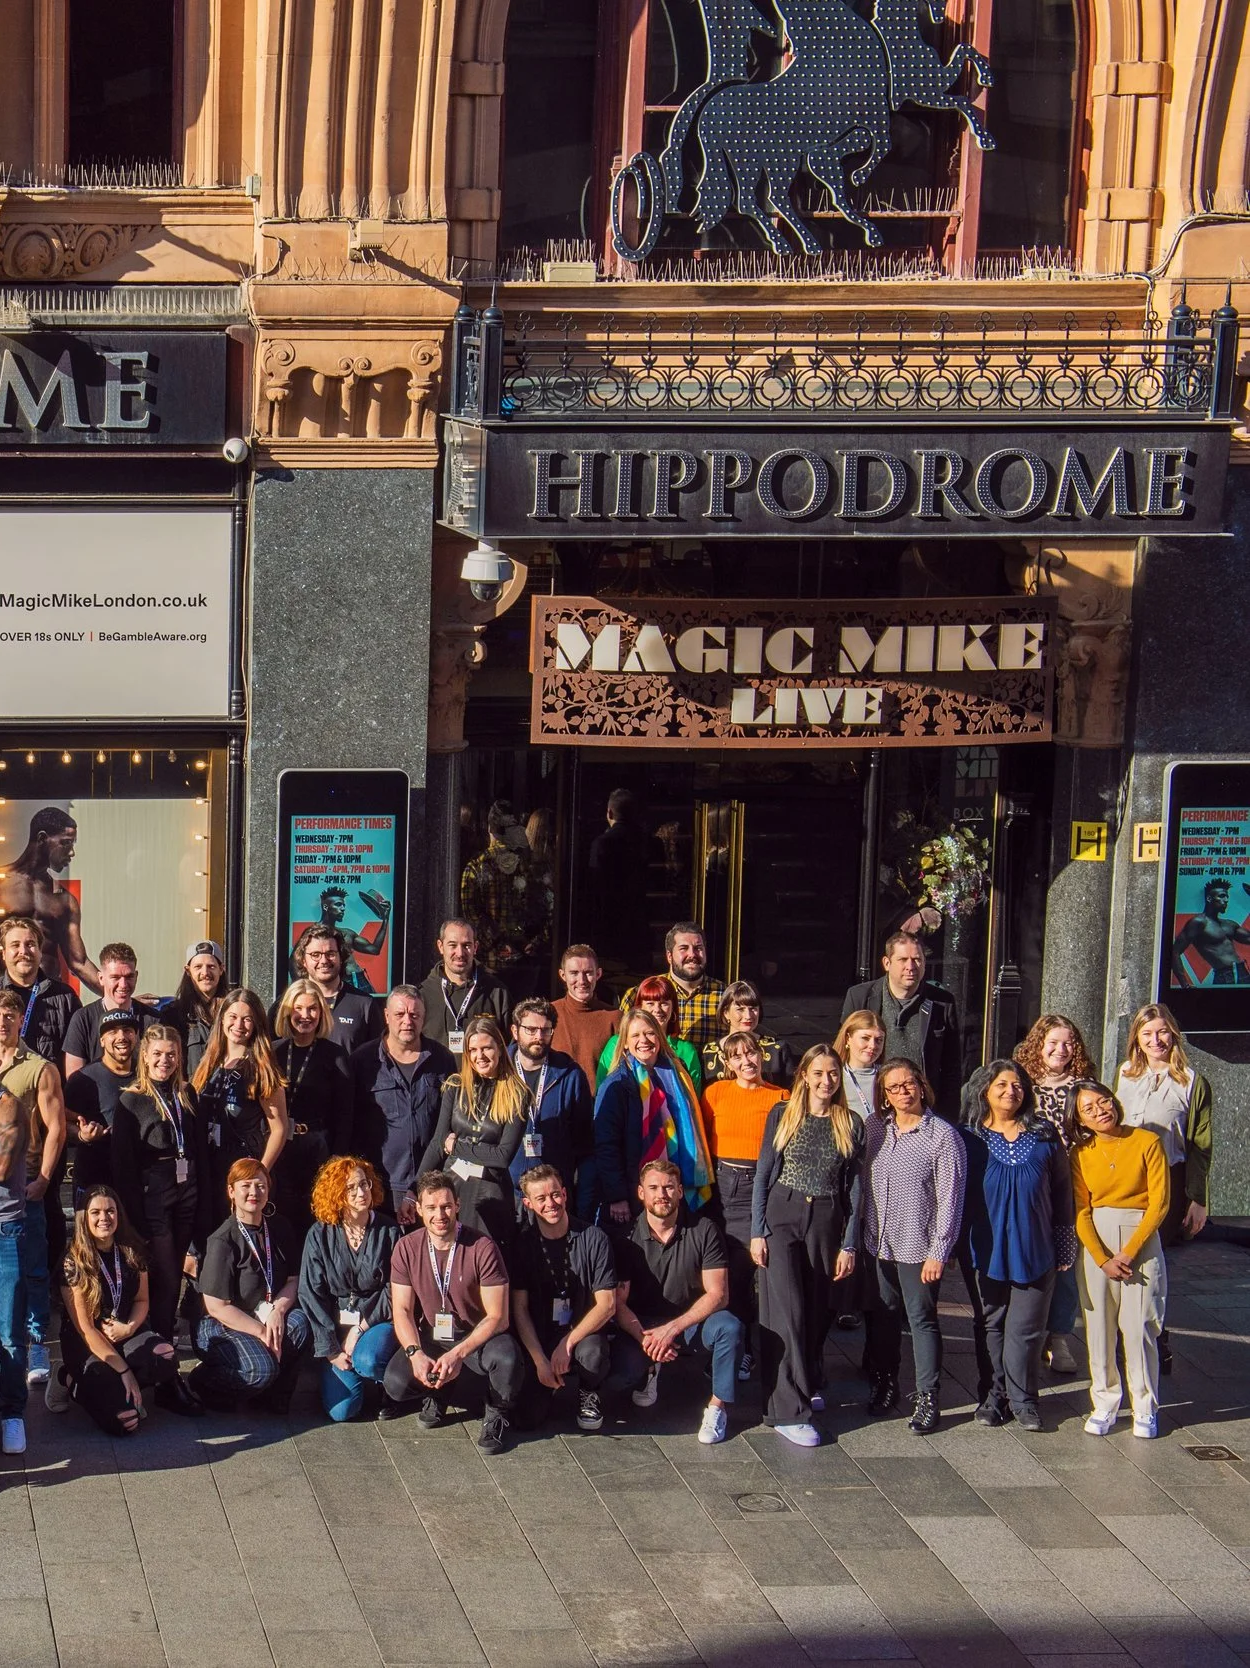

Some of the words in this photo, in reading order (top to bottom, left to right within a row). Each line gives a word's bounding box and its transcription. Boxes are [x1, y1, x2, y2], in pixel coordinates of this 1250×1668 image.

[526, 446, 1188, 520] HIPPODROME
[0, 593, 208, 612] MagicMikeLondon.co.uk
[0, 631, 32, 642] OVER
[34, 631, 51, 642] 18s
[54, 631, 85, 642] ONLY
[98, 631, 207, 644] BeGambleAware.org
[556, 623, 814, 673] MAGIC
[839, 623, 1045, 673] MIKE
[730, 687, 884, 725] LIVE
[953, 806, 985, 820] BOX
[1182, 810, 1249, 822] PERFORMANCE
[294, 817, 362, 830] PERFORMANCE
[363, 817, 392, 829] TIMES
[1182, 827, 1220, 836] WEDNESDAY
[1225, 827, 1240, 835] 7PM
[294, 834, 335, 843] WEDNESDAY
[339, 834, 354, 843] 7PM
[294, 845, 329, 854] THURSDAY
[334, 845, 349, 853] 7PM
[355, 845, 373, 853] 10PM
[1180, 847, 1204, 856] FRIDAY
[1207, 847, 1222, 855] 7PM
[1229, 846, 1247, 855] 10PM
[294, 855, 318, 864] FRIDAY
[322, 855, 337, 863] 7PM
[337, 855, 342, 863] &
[343, 855, 361, 863] 10PM
[294, 865, 327, 874] SATURDAY
[350, 865, 365, 873] 7PM
[372, 865, 390, 873] 10PM
[1179, 867, 1205, 876] SUNDAY
[1208, 867, 1224, 875] 4PM
[1231, 867, 1246, 875] 7PM
[294, 875, 320, 884] SUNDAY
[324, 875, 340, 883] 4PM
[346, 875, 361, 883] 7PM
